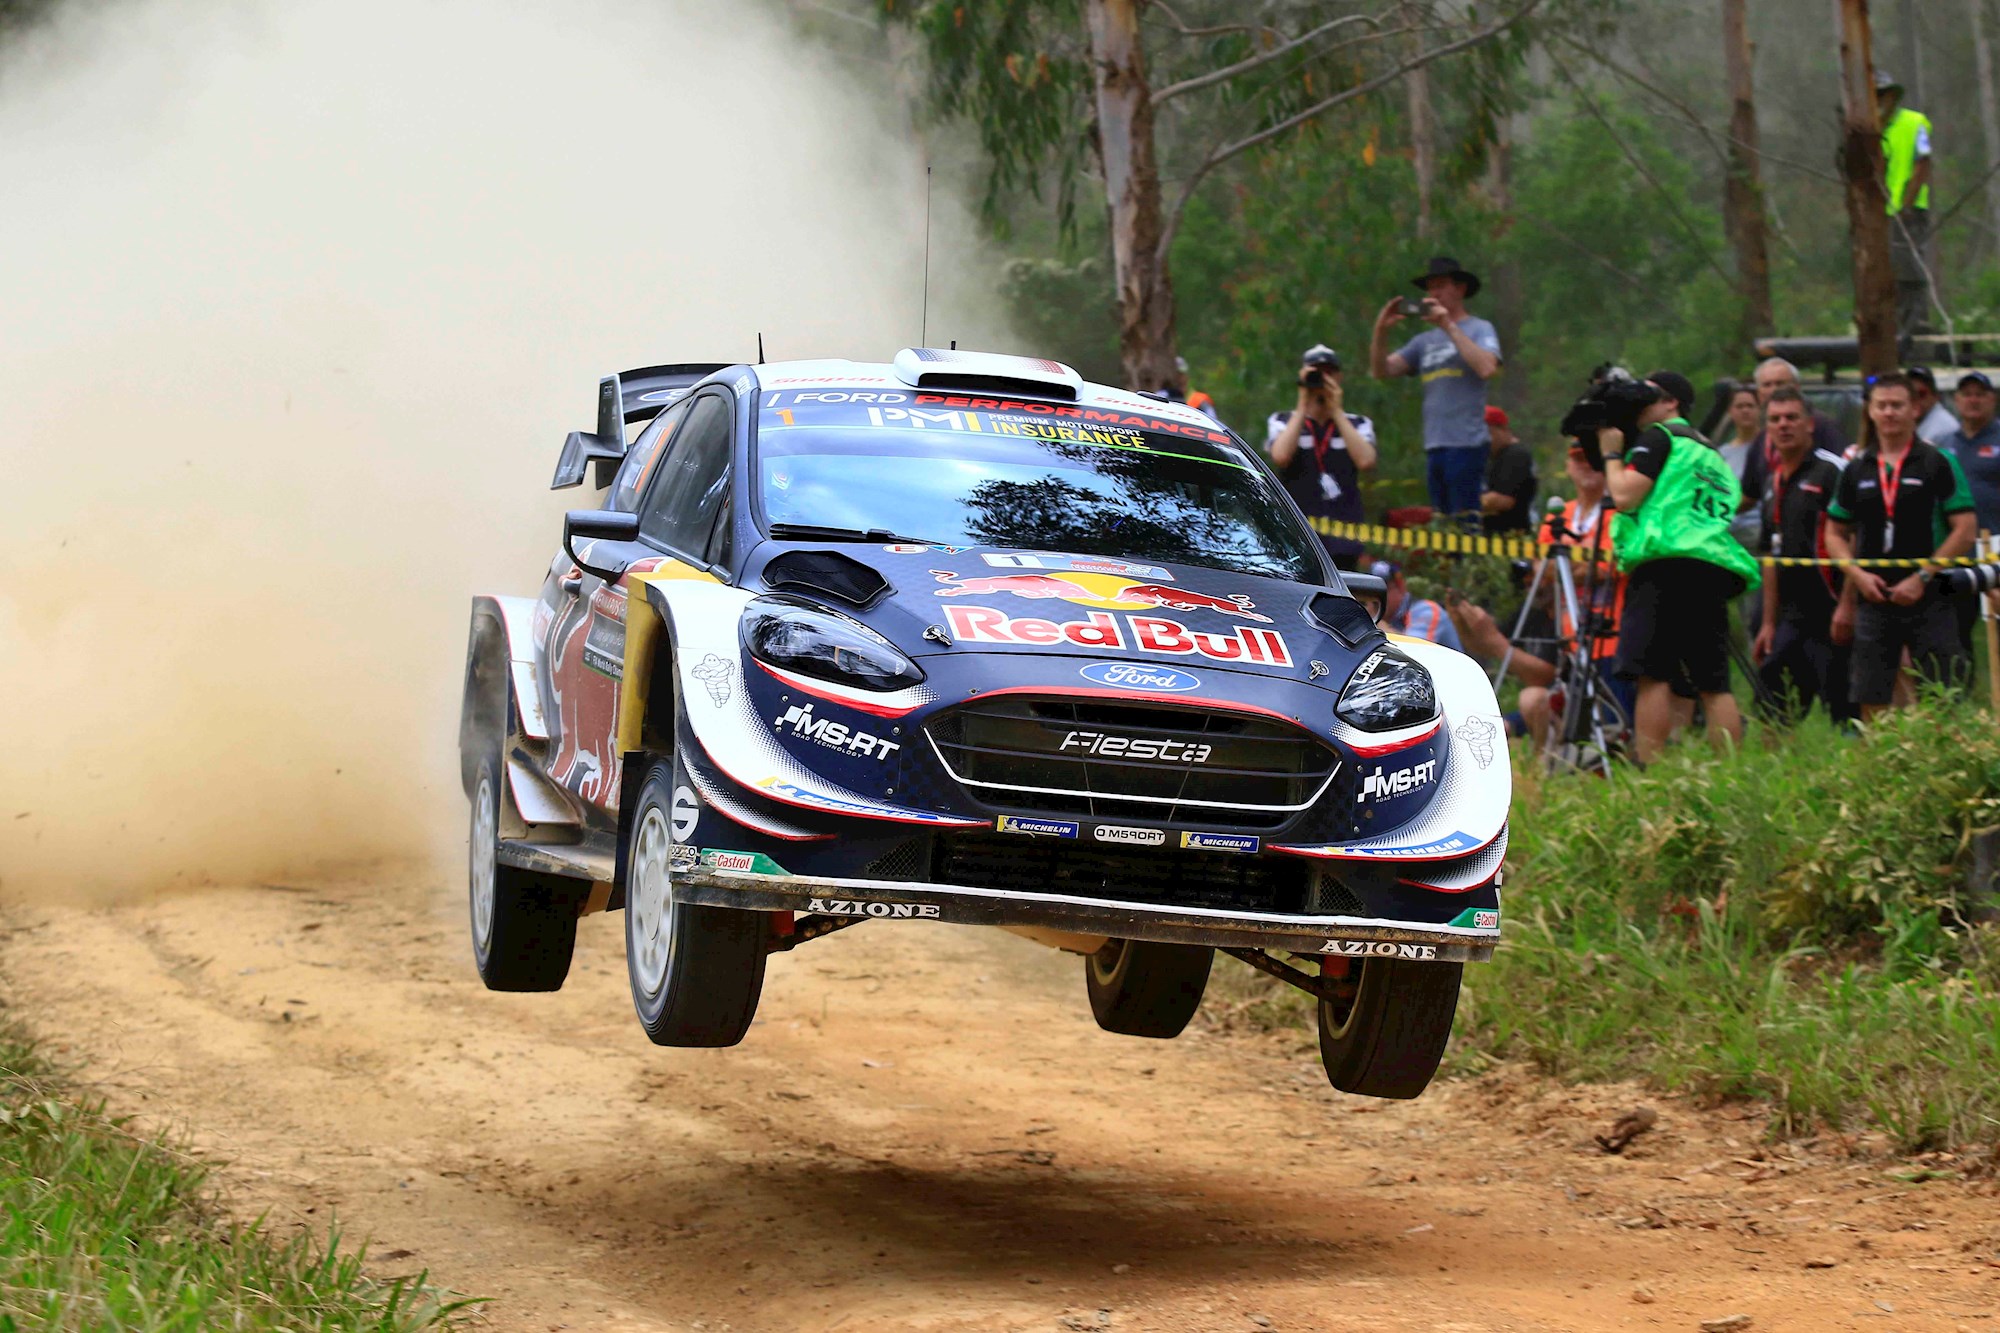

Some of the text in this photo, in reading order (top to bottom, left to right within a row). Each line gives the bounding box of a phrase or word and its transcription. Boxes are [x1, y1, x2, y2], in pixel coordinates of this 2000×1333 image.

[775, 408, 795, 426] 1
[794, 392, 1231, 446] FORD PERFORMANCE
[867, 407, 983, 433] PMI
[988, 413, 1141, 437] PREMIUM MOTORSPORT
[990, 420, 1150, 449] INSURANCE
[946, 605, 1290, 666] Red Bull
[1103, 664, 1177, 688] Ford
[790, 731, 863, 759] ROAD TECHNOLOGY
[792, 711, 901, 761] MS-RT
[1059, 730, 1212, 763] Fiesta
[1375, 758, 1436, 798] MS-RT
[1375, 785, 1425, 803] ROAD TECHNOLOGY
[1020, 822, 1072, 834] MICHELIN
[1202, 838, 1253, 848] MICHELIN
[1372, 838, 1465, 856] MICHELIN
[717, 854, 751, 870] Castrol
[807, 897, 941, 918] AZIONE
[1318, 939, 1437, 960] AZIONE
